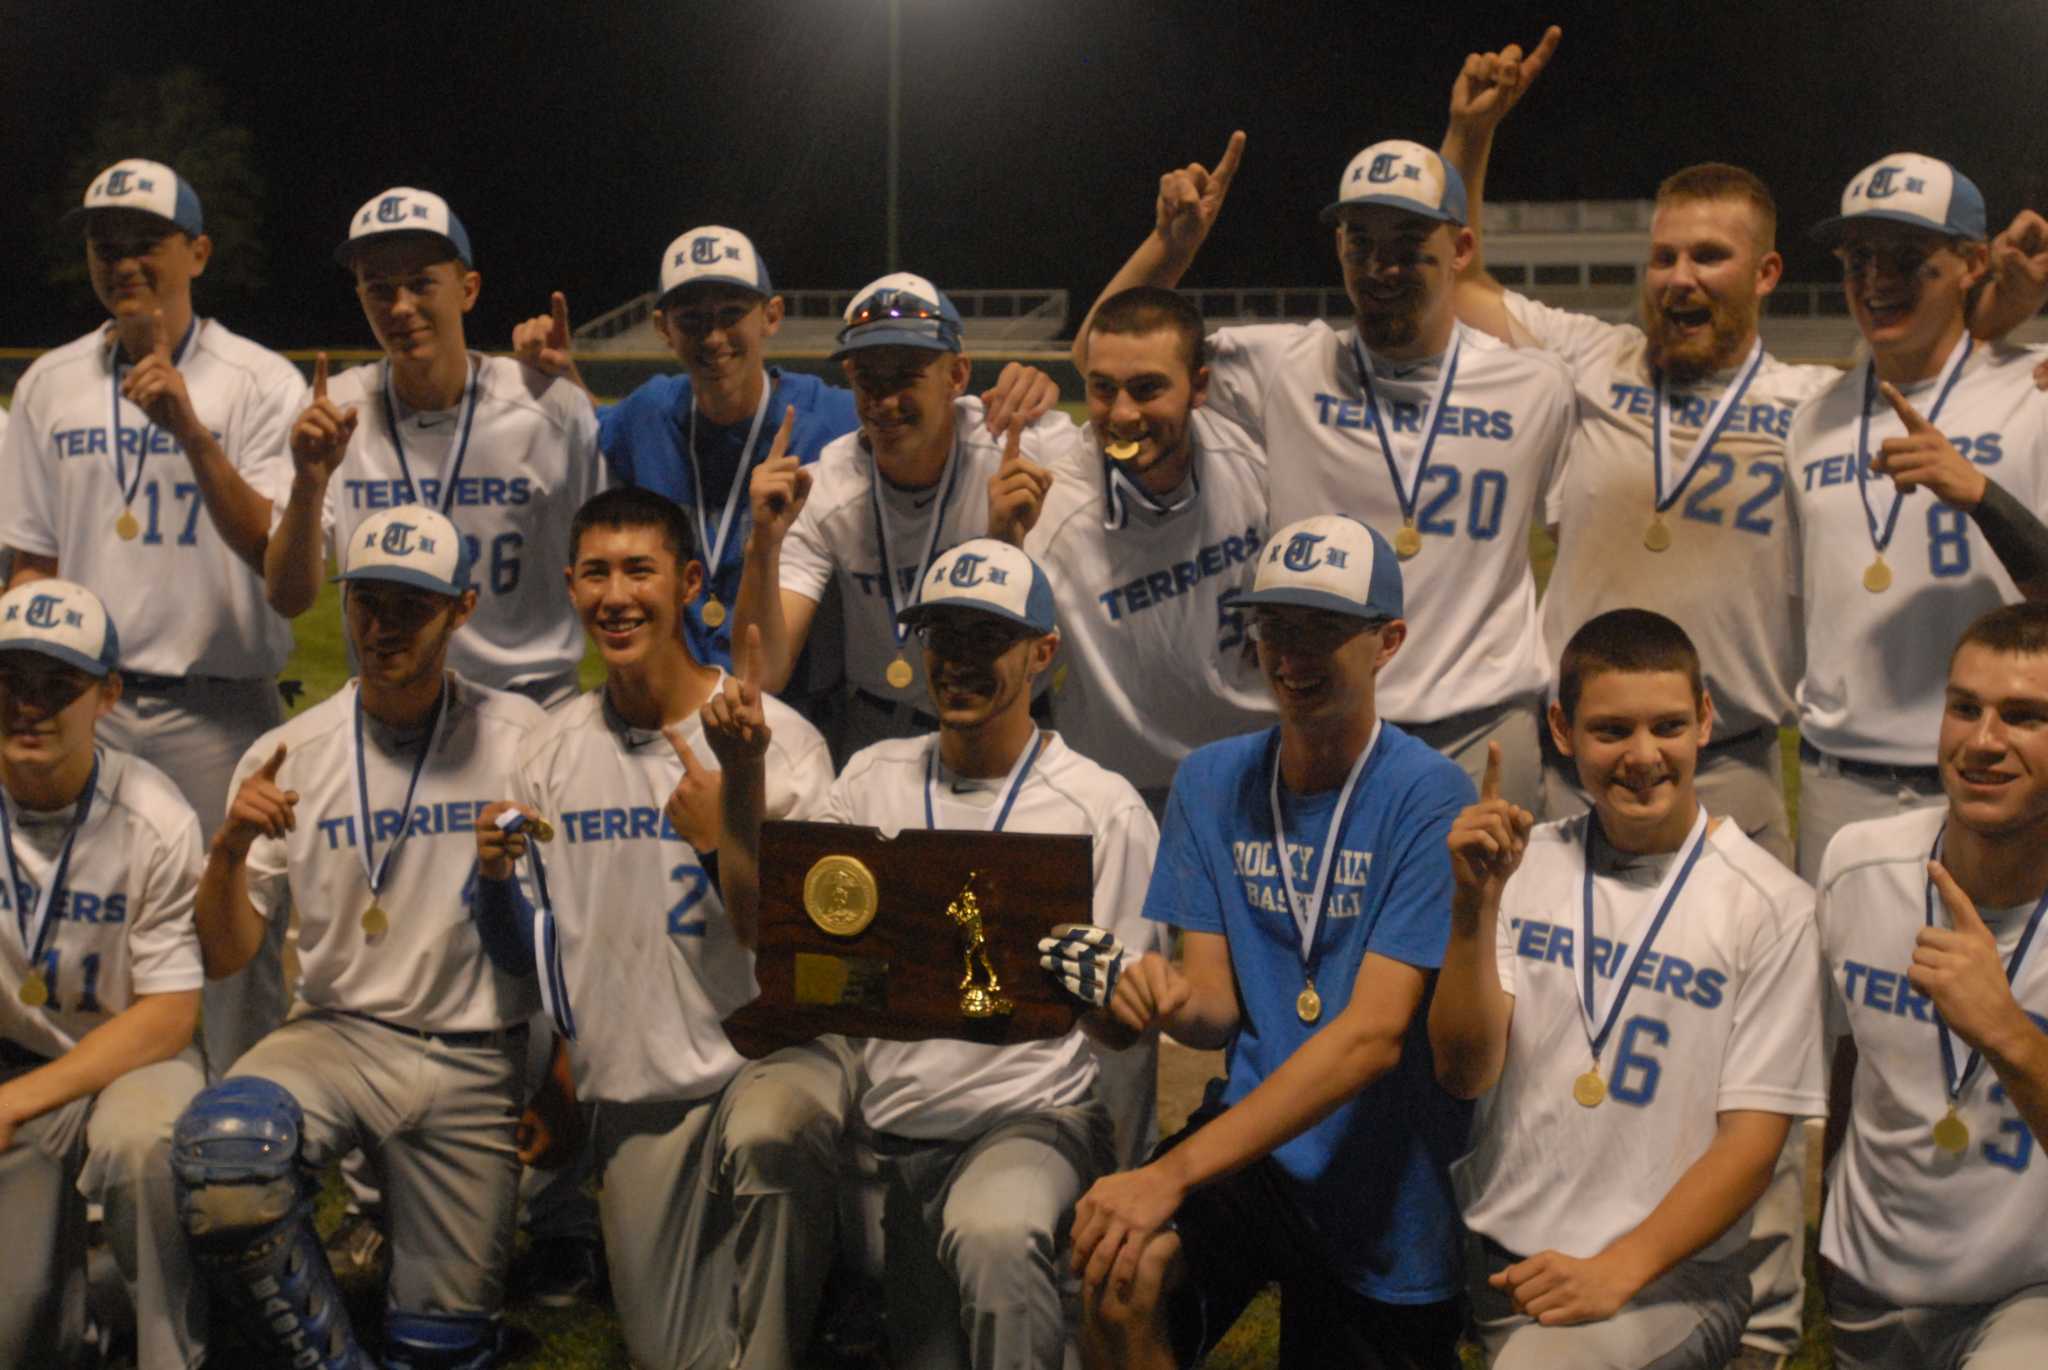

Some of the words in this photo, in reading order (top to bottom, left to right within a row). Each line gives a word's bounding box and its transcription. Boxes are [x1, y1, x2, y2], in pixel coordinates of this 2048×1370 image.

[1611, 383, 1793, 438] TERIERS
[143, 479, 204, 545] 17
[344, 476, 531, 509] TERRERS
[1417, 464, 1508, 541] 20
[1682, 452, 1785, 536] 22
[1099, 525, 1262, 620] TERRERS
[1926, 501, 1971, 578] 8
[561, 806, 687, 844] TERR
[667, 863, 708, 937] 2
[43, 948, 103, 1013] 11
[1511, 917, 1728, 1009] ERRIERS
[1608, 1013, 1670, 1108] 6
